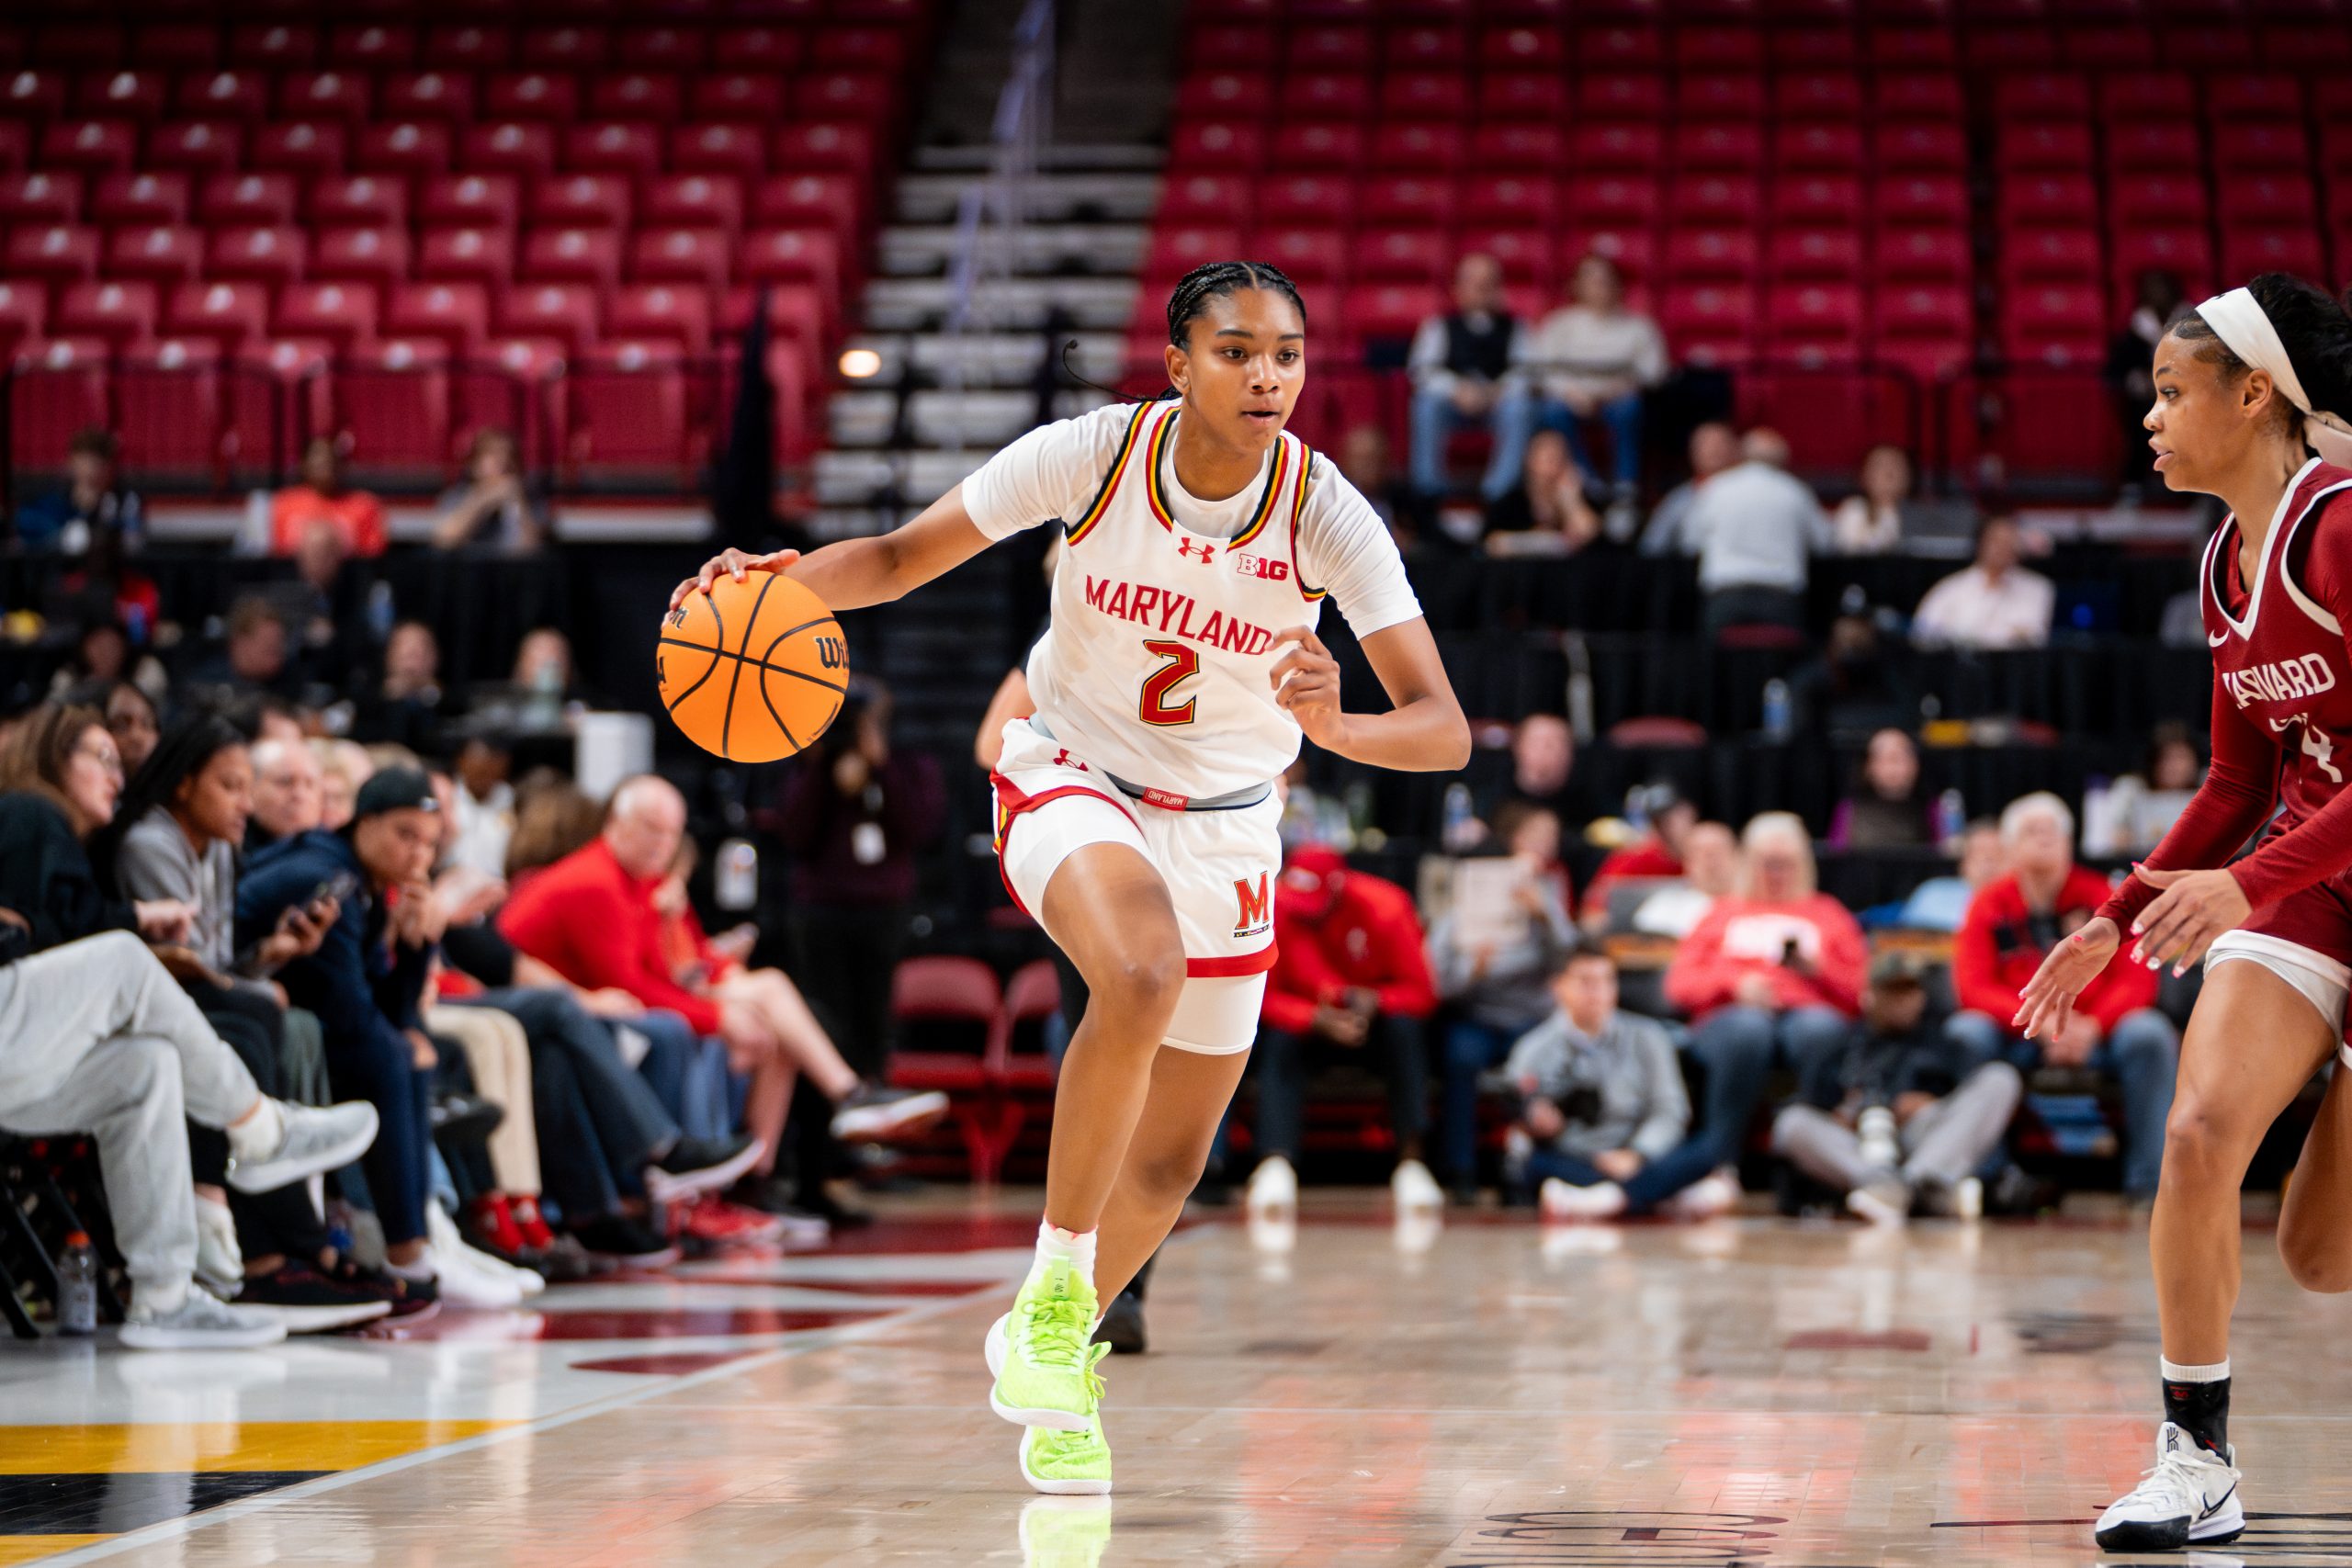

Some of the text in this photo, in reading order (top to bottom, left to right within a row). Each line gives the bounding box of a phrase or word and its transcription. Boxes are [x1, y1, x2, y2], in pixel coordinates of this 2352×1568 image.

[1085, 574, 1272, 656] MARYLAND
[1139, 638, 1200, 727] 2
[1148, 790, 1184, 806] MARYLAND
[1234, 870, 1270, 930] M
